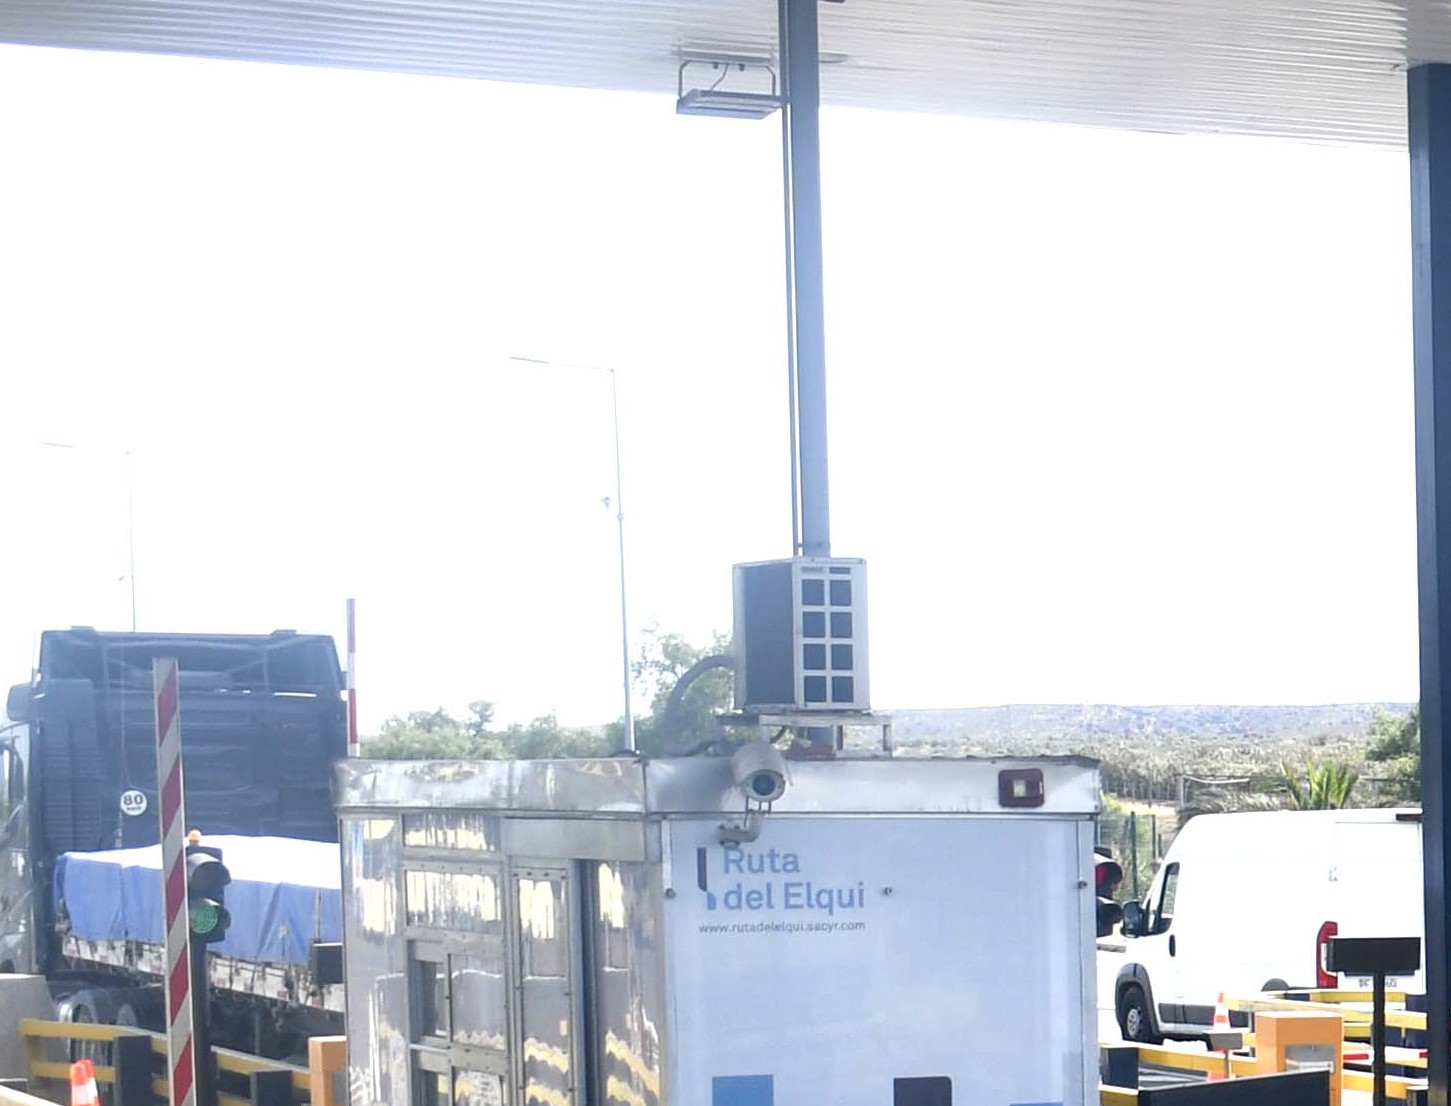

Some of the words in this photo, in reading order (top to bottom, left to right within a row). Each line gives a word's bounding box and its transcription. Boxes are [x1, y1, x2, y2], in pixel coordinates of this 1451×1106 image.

[123, 794, 144, 806] 80
[723, 848, 801, 874] Ruta
[723, 882, 774, 910] del
[784, 881, 865, 916] Elqui
[699, 921, 866, 934] www.rutadelelqui.sacyr.com
